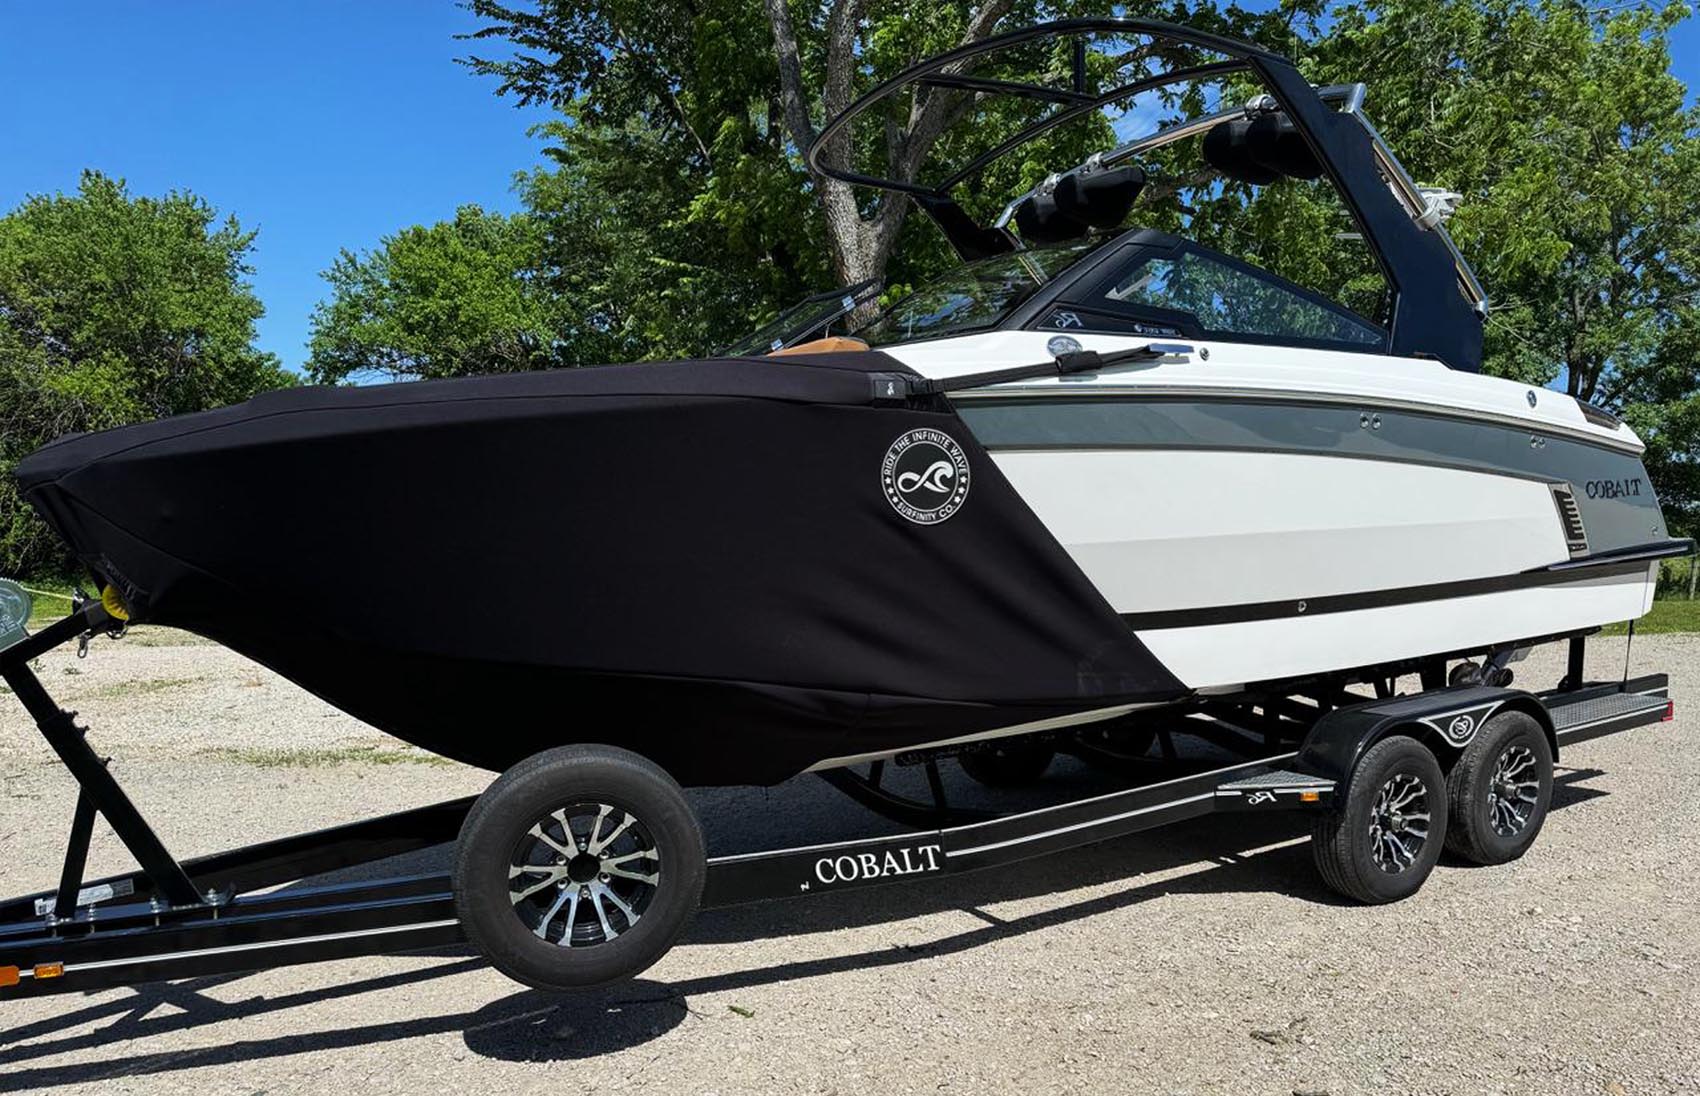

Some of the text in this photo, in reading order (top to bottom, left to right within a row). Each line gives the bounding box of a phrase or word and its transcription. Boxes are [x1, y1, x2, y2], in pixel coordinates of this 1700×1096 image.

[883, 431, 967, 476] RIDE THE INFINITE WAVE
[896, 502, 937, 521] SURFINITY
[815, 845, 941, 884] COBALT
